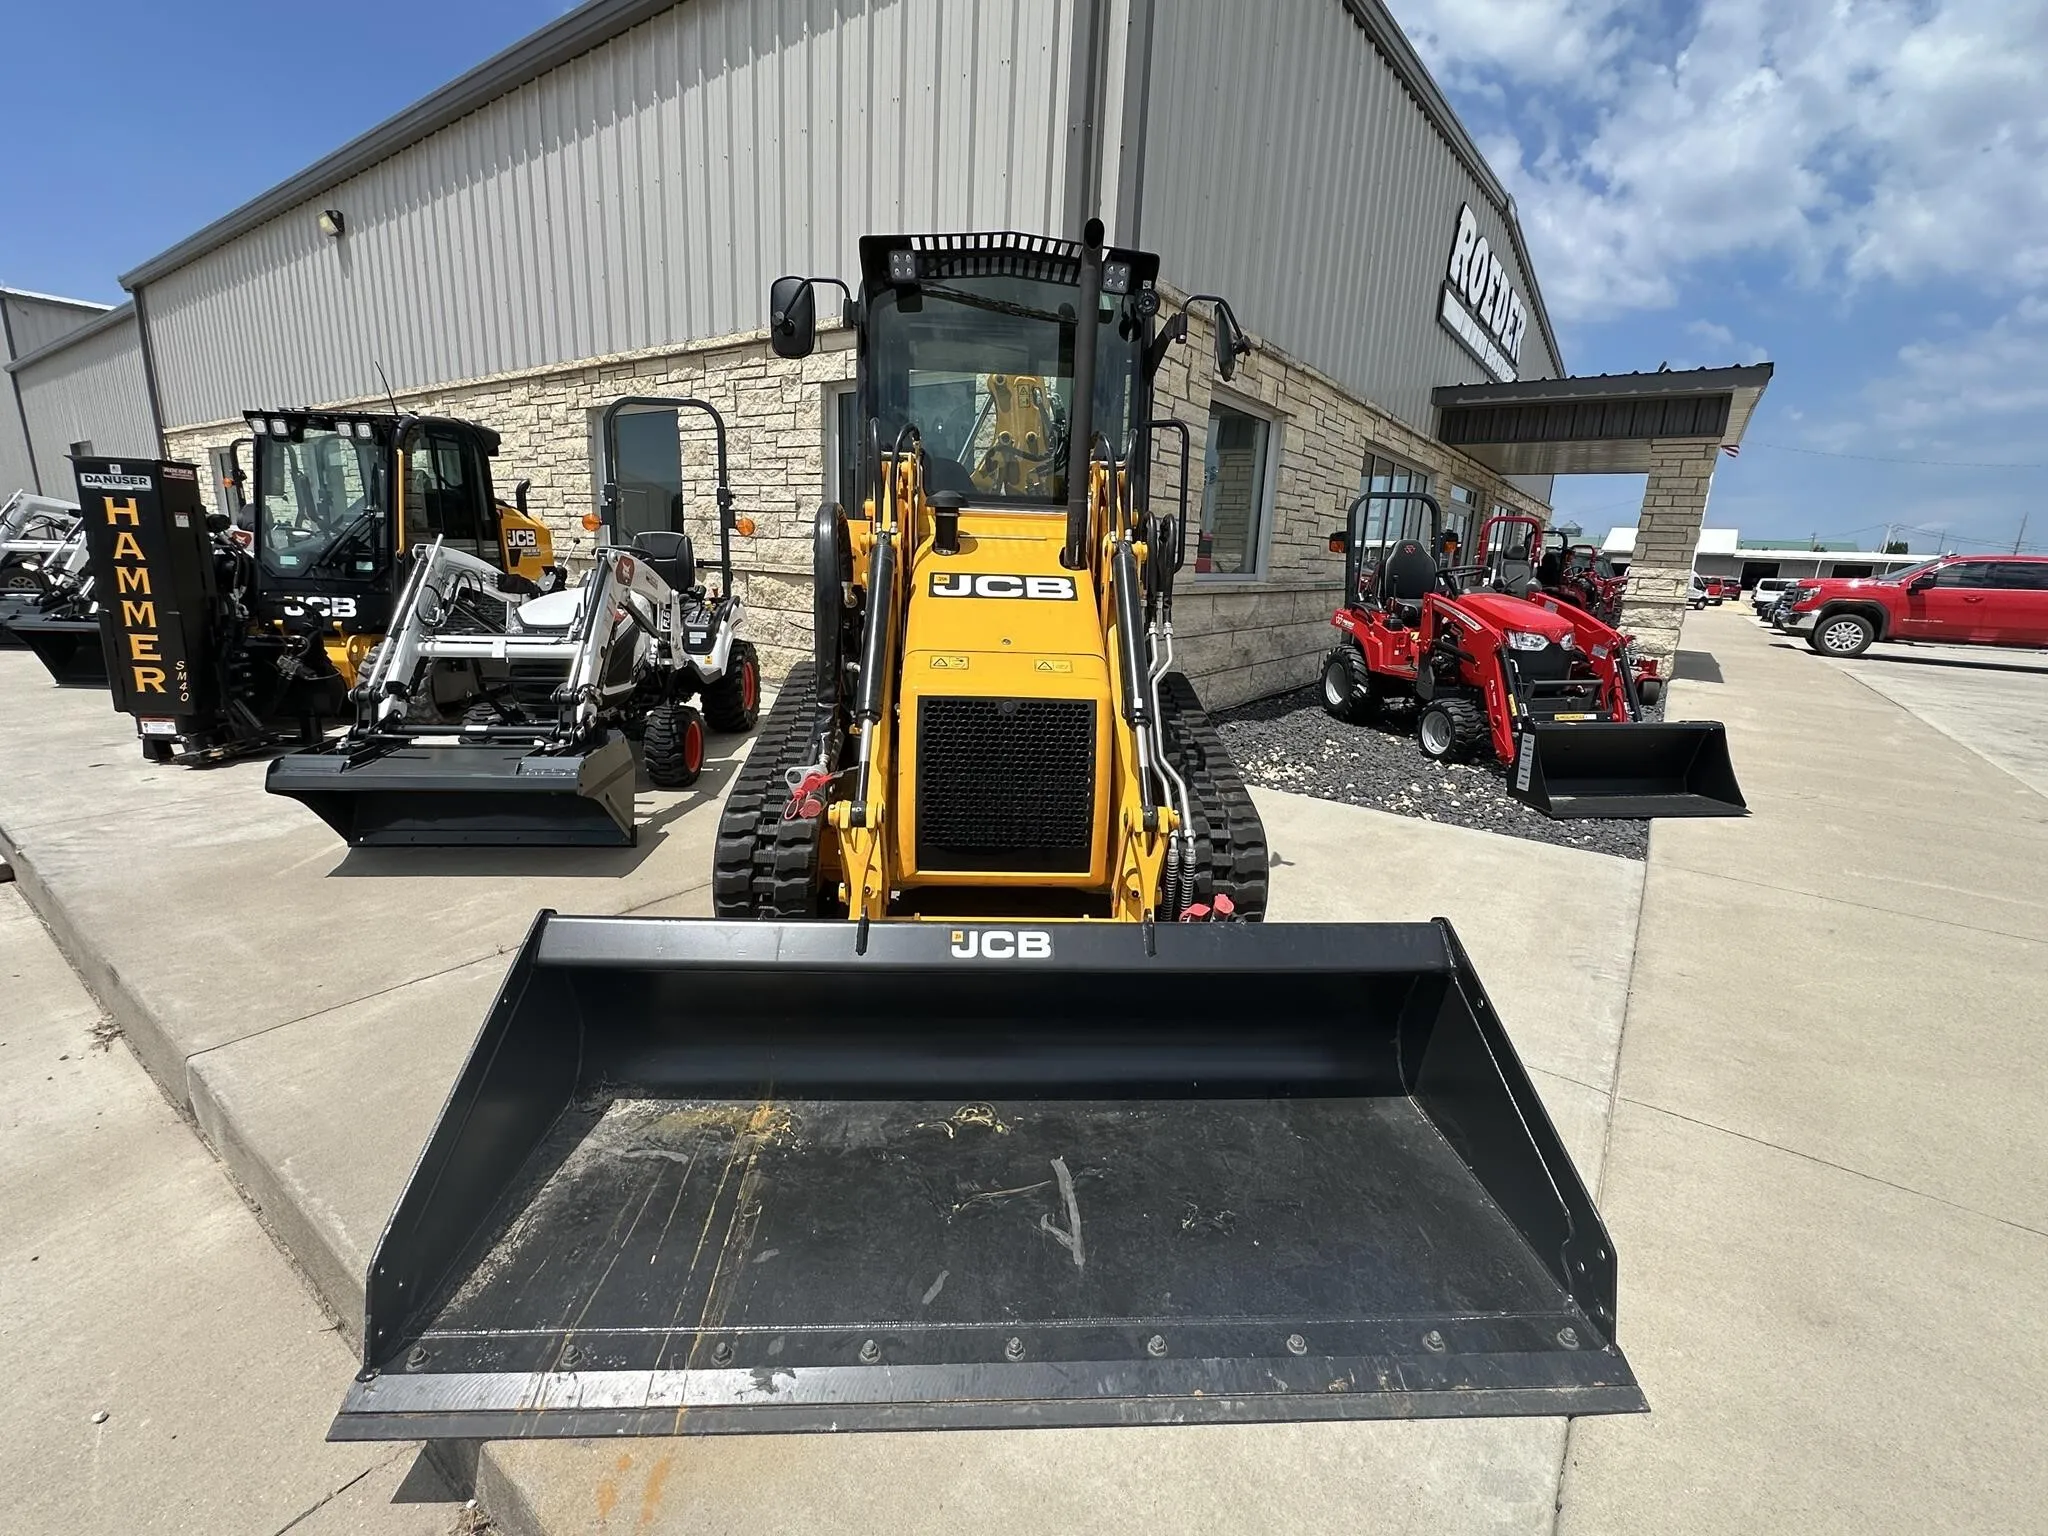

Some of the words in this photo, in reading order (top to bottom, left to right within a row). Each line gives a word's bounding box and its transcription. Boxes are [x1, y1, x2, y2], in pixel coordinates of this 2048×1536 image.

[1449, 203, 1527, 365] ROEDER
[84, 474, 148, 486] DANUSER
[507, 529, 536, 547] JCB
[102, 496, 168, 694] HAMMER
[932, 574, 1074, 599] JCB
[283, 595, 357, 618] JCB
[175, 660, 190, 702] SM40
[951, 930, 1052, 959] JCB
